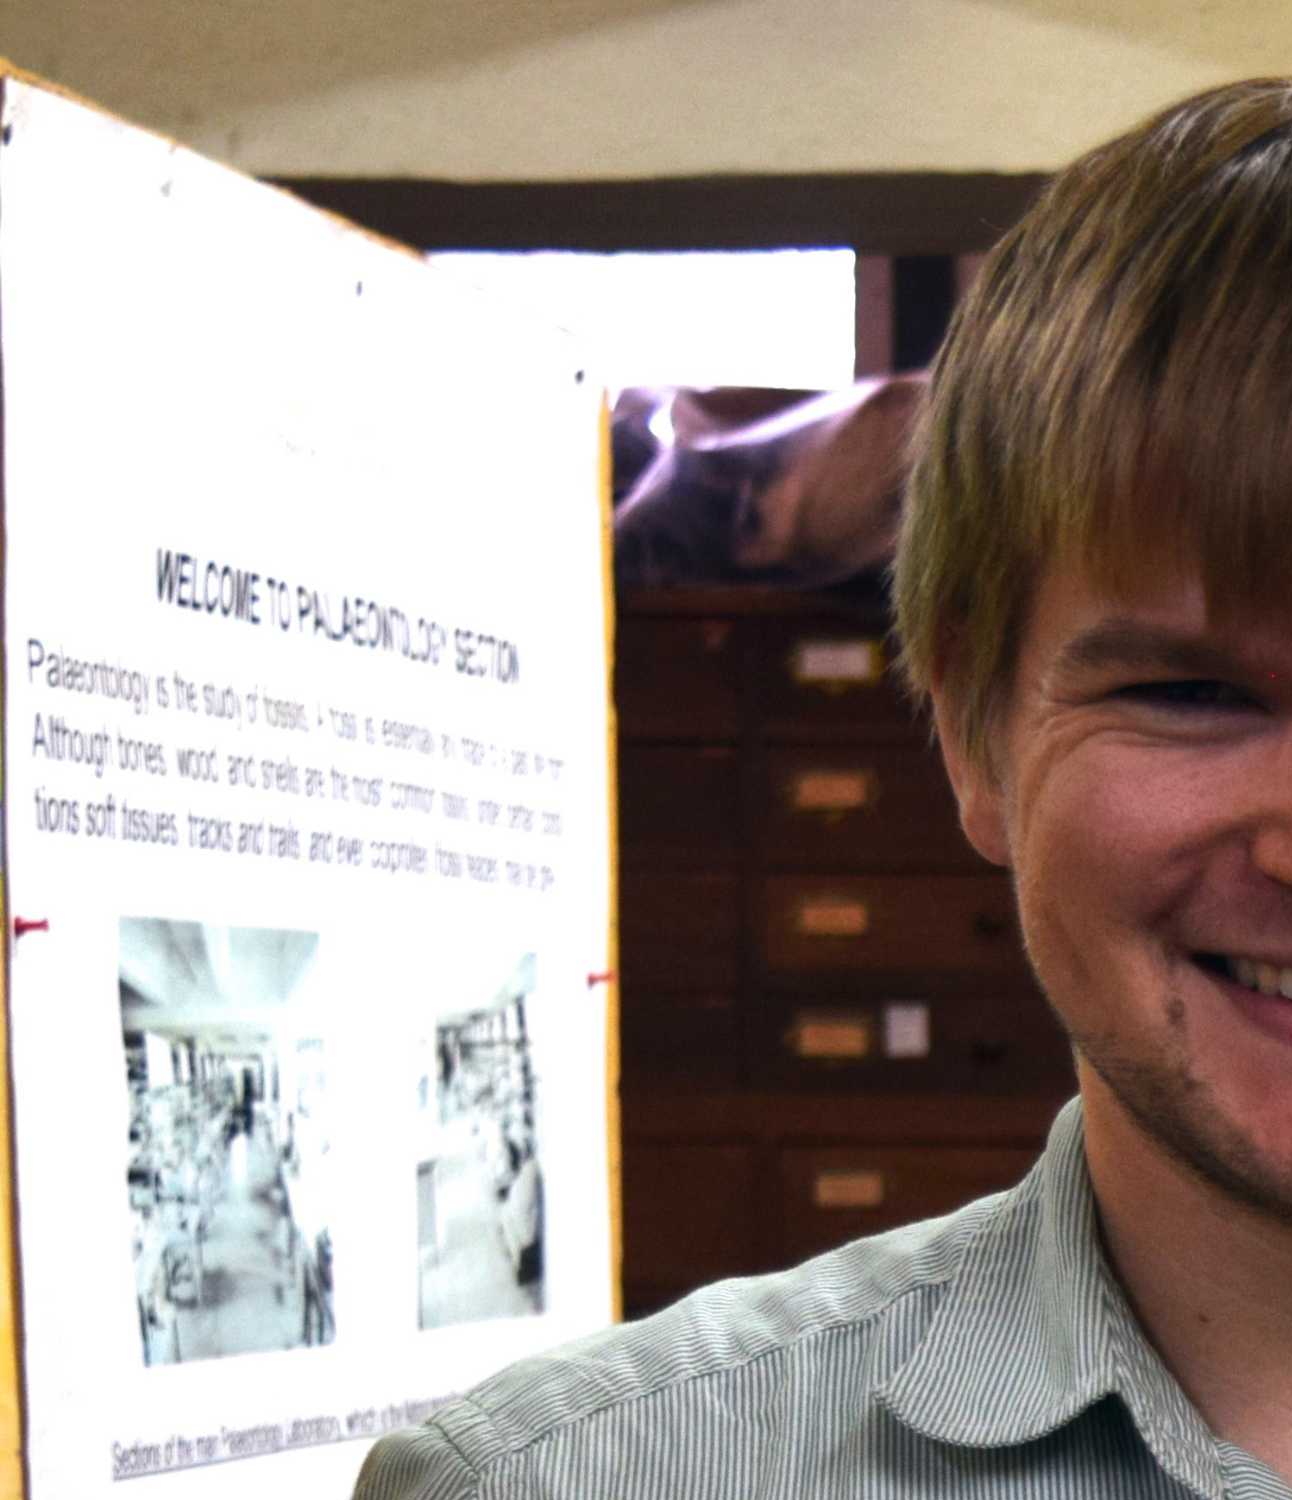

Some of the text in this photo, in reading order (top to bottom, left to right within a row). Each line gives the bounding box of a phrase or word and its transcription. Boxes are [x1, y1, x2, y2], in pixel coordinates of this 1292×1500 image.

[155, 547, 261, 626] WELCOME
[266, 576, 292, 633] TO
[456, 627, 520, 685] SECTION
[26, 637, 149, 716] Palaeontology
[156, 674, 169, 710] is
[173, 669, 198, 714] the
[202, 679, 242, 731] study
[32, 711, 113, 779] Although
[33, 784, 81, 837] tions
[84, 791, 117, 841] soft
